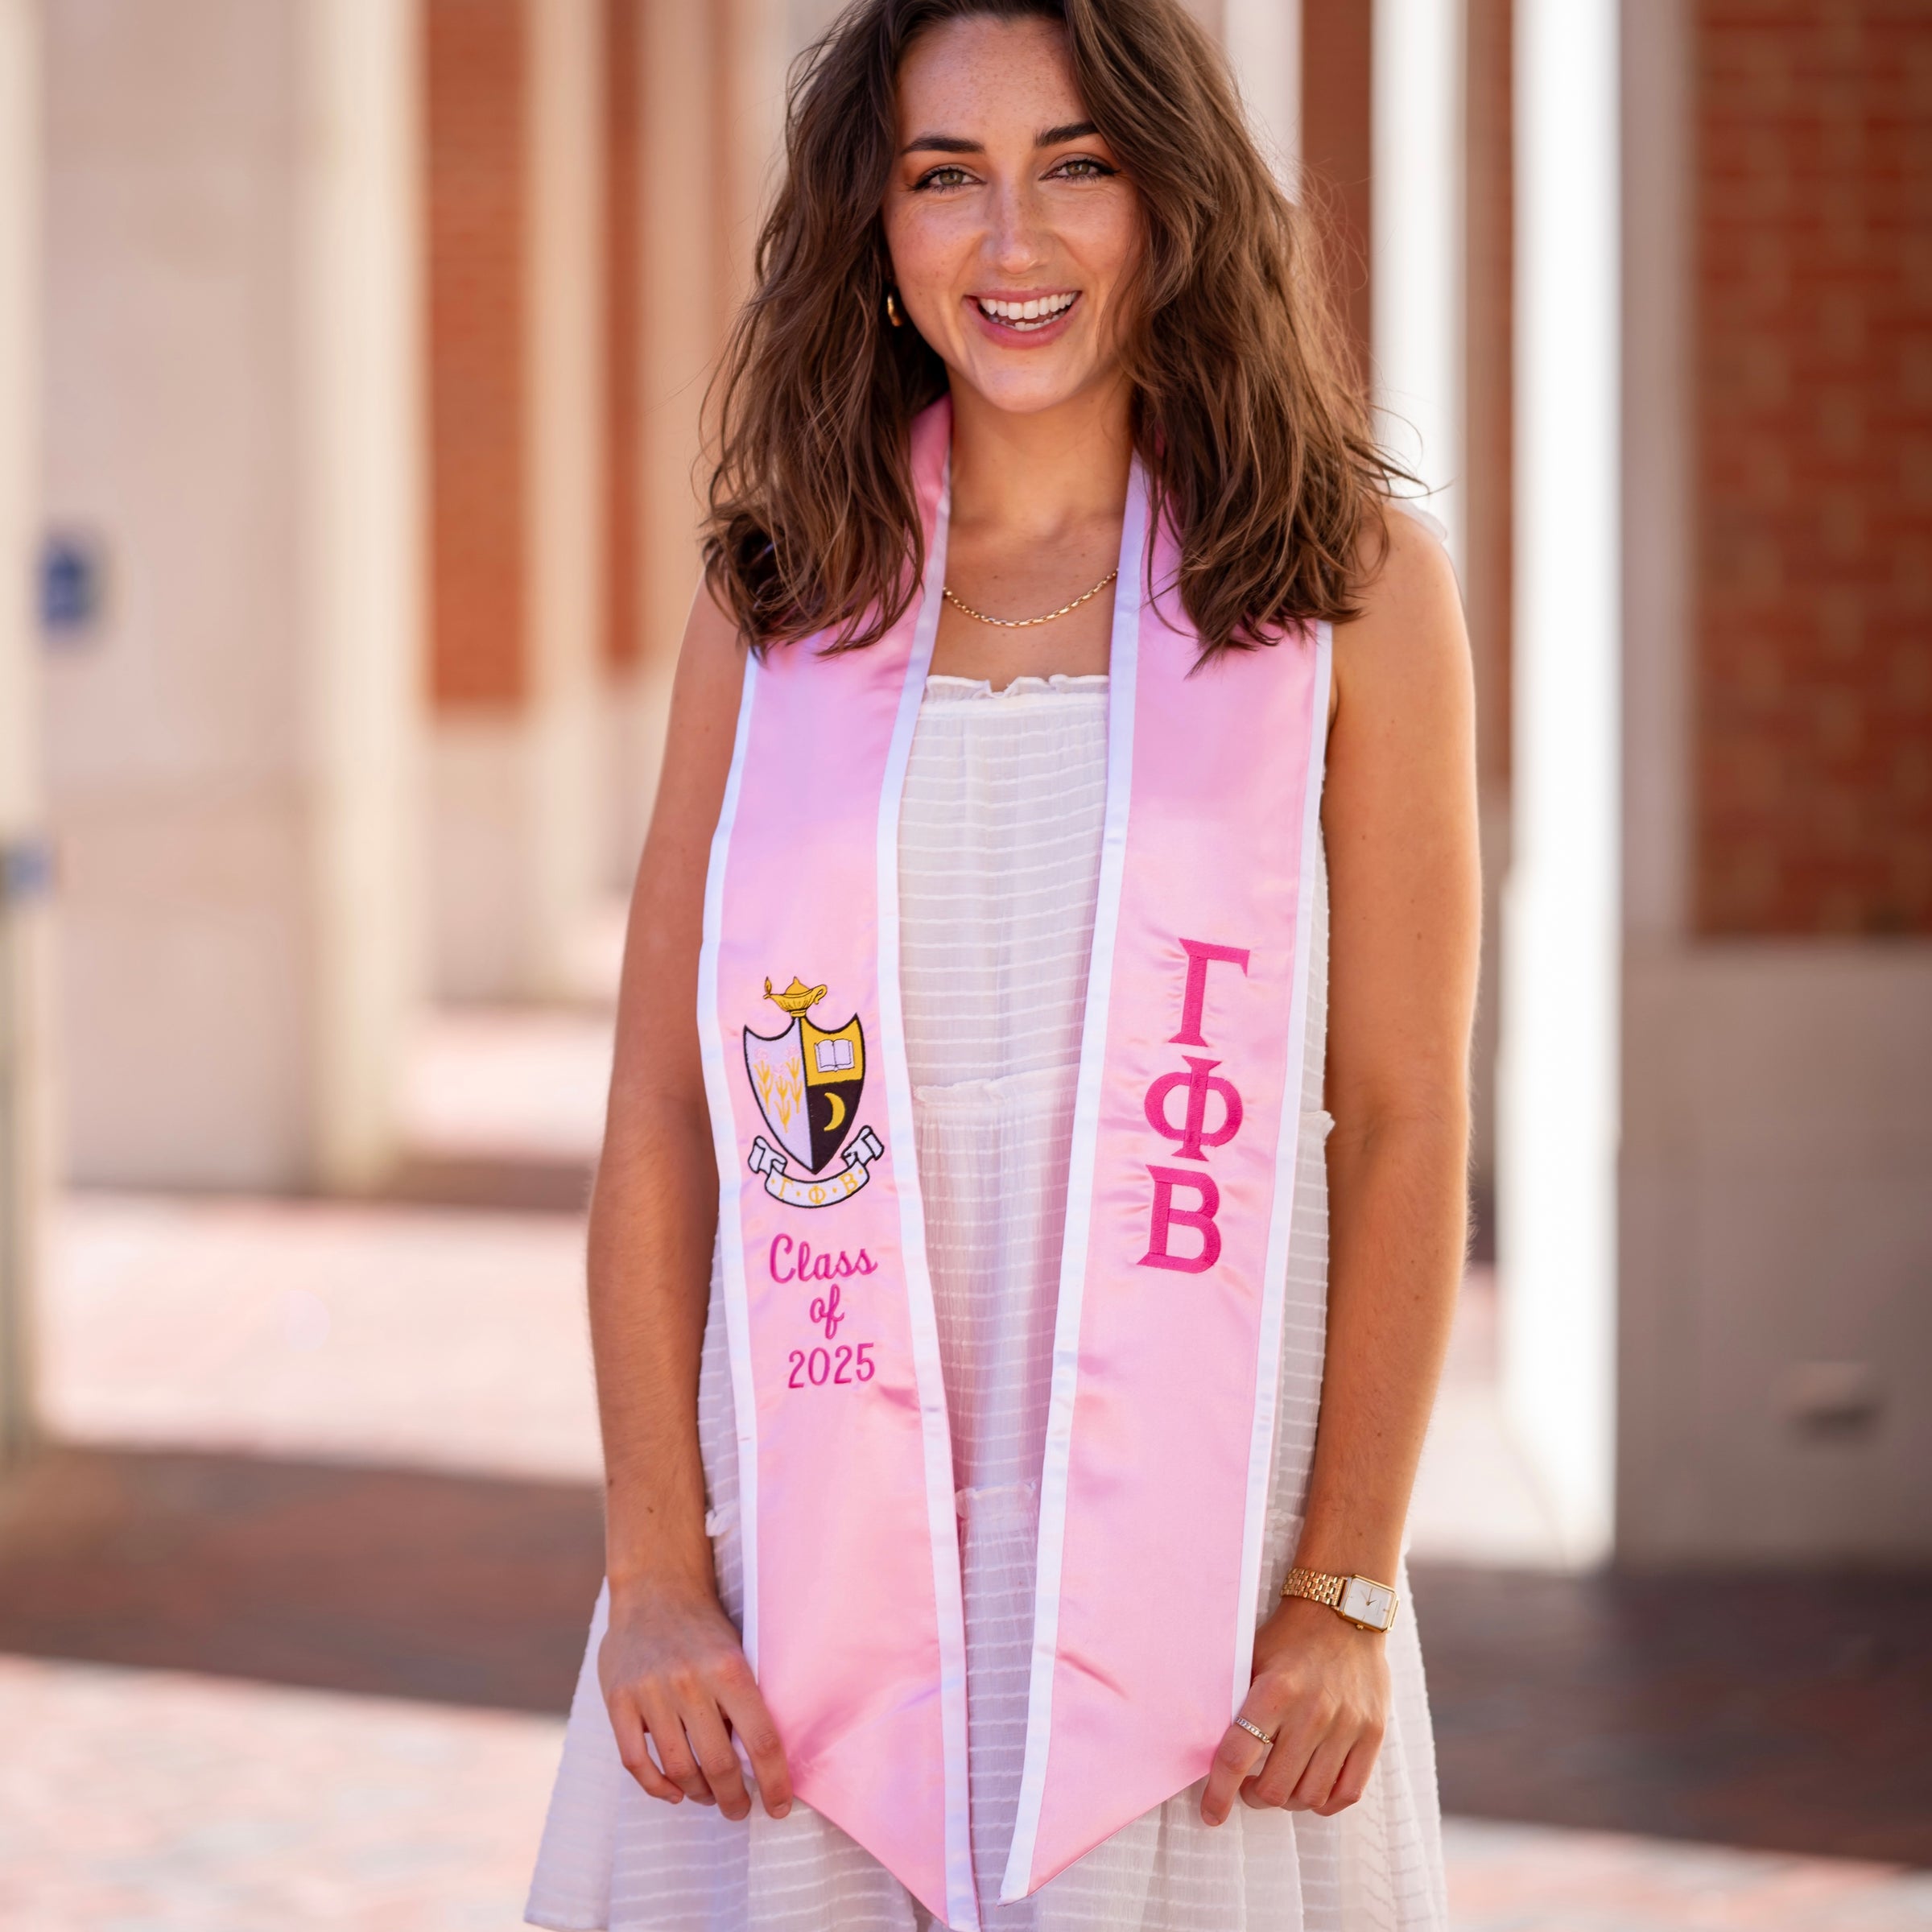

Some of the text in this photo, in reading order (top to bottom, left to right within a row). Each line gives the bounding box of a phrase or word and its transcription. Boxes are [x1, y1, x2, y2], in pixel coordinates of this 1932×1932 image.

[770, 1233, 878, 1283] Class
[810, 1283, 845, 1340] of
[788, 1343, 875, 1389] 2025
